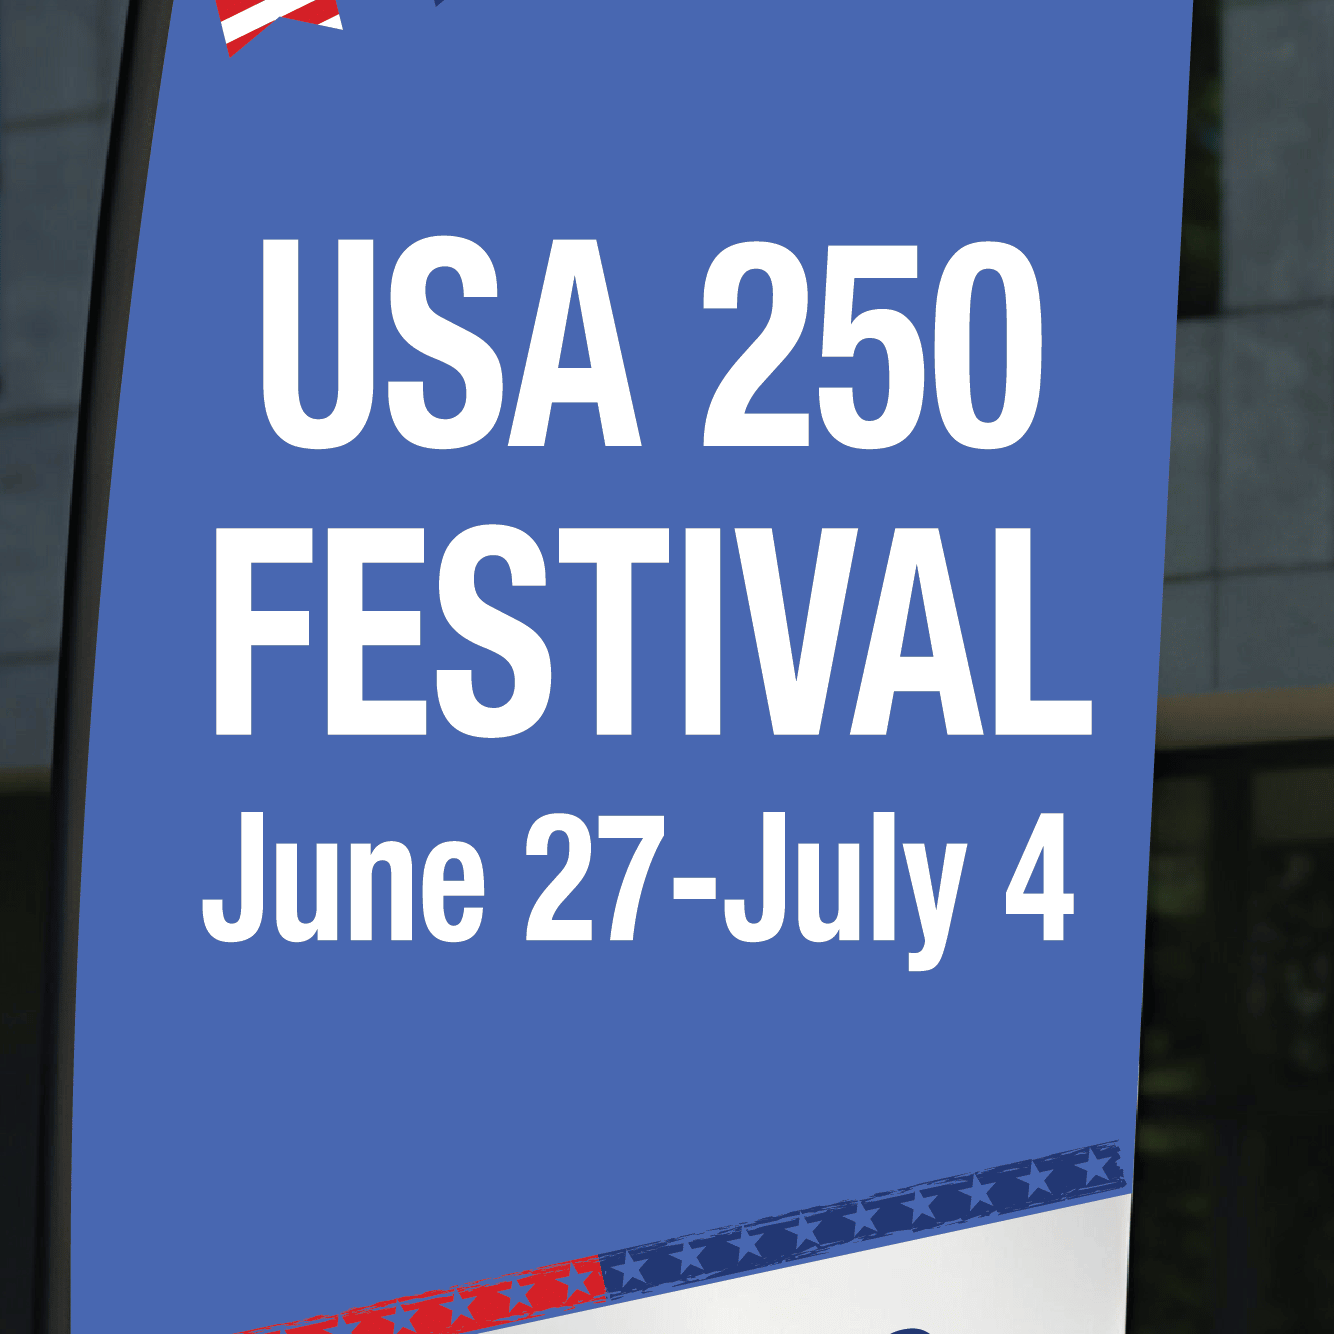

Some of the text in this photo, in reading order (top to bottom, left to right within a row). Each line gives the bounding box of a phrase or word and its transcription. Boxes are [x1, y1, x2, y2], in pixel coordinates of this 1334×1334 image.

[263, 235, 1043, 450] USA 250
[216, 523, 1093, 739] FESTIVAL
[202, 811, 1075, 972] June 27-July 4
